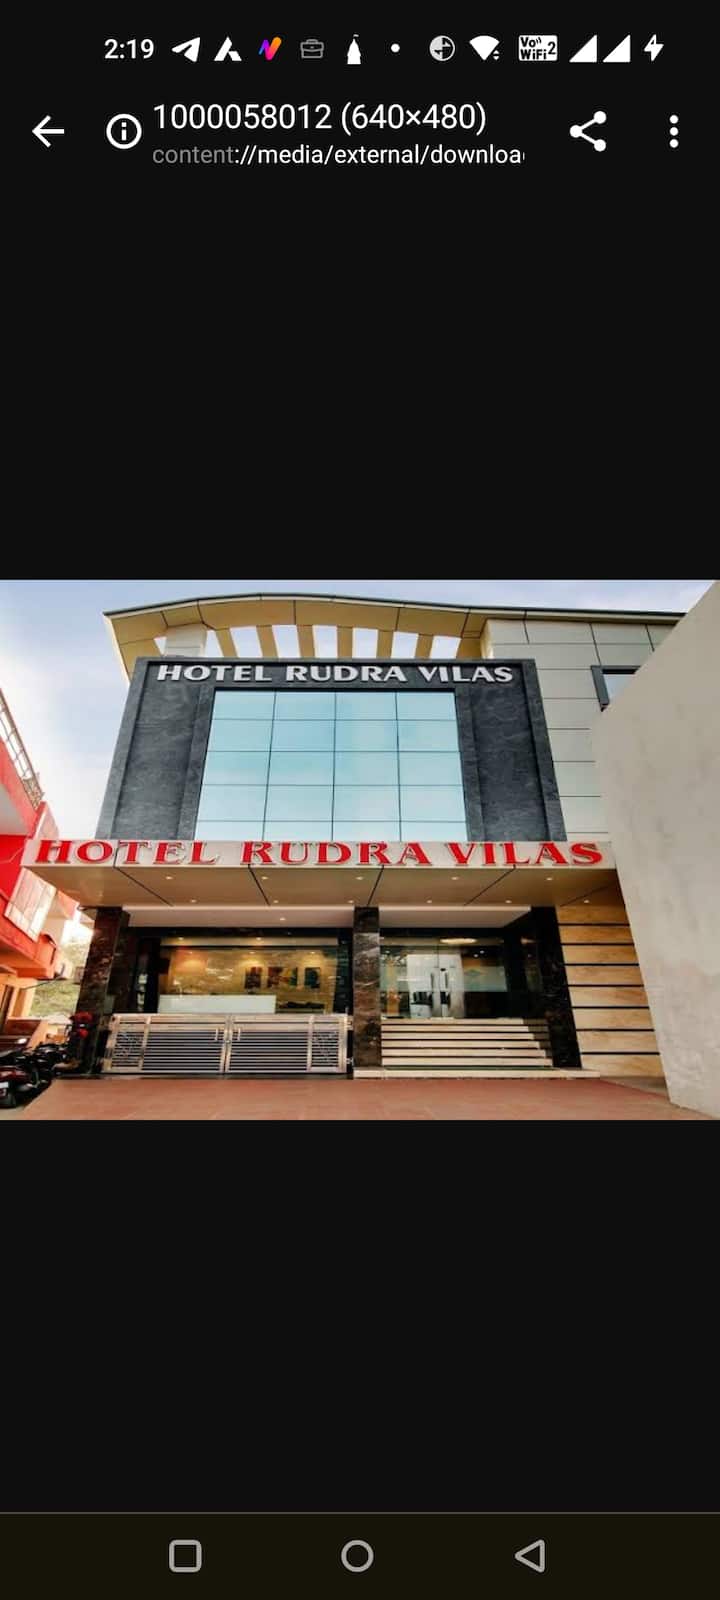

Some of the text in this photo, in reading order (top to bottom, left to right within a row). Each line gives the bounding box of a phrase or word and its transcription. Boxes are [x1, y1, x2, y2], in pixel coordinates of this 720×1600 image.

[104, 38, 154, 60] 2:19
[153, 104, 333, 129] 1000058012
[152, 144, 525, 165] content://media/external/downloa
[157, 664, 514, 683] HOTEL RUDRA VILAS
[35, 839, 605, 866] HOTEL RUDRA VILAS
